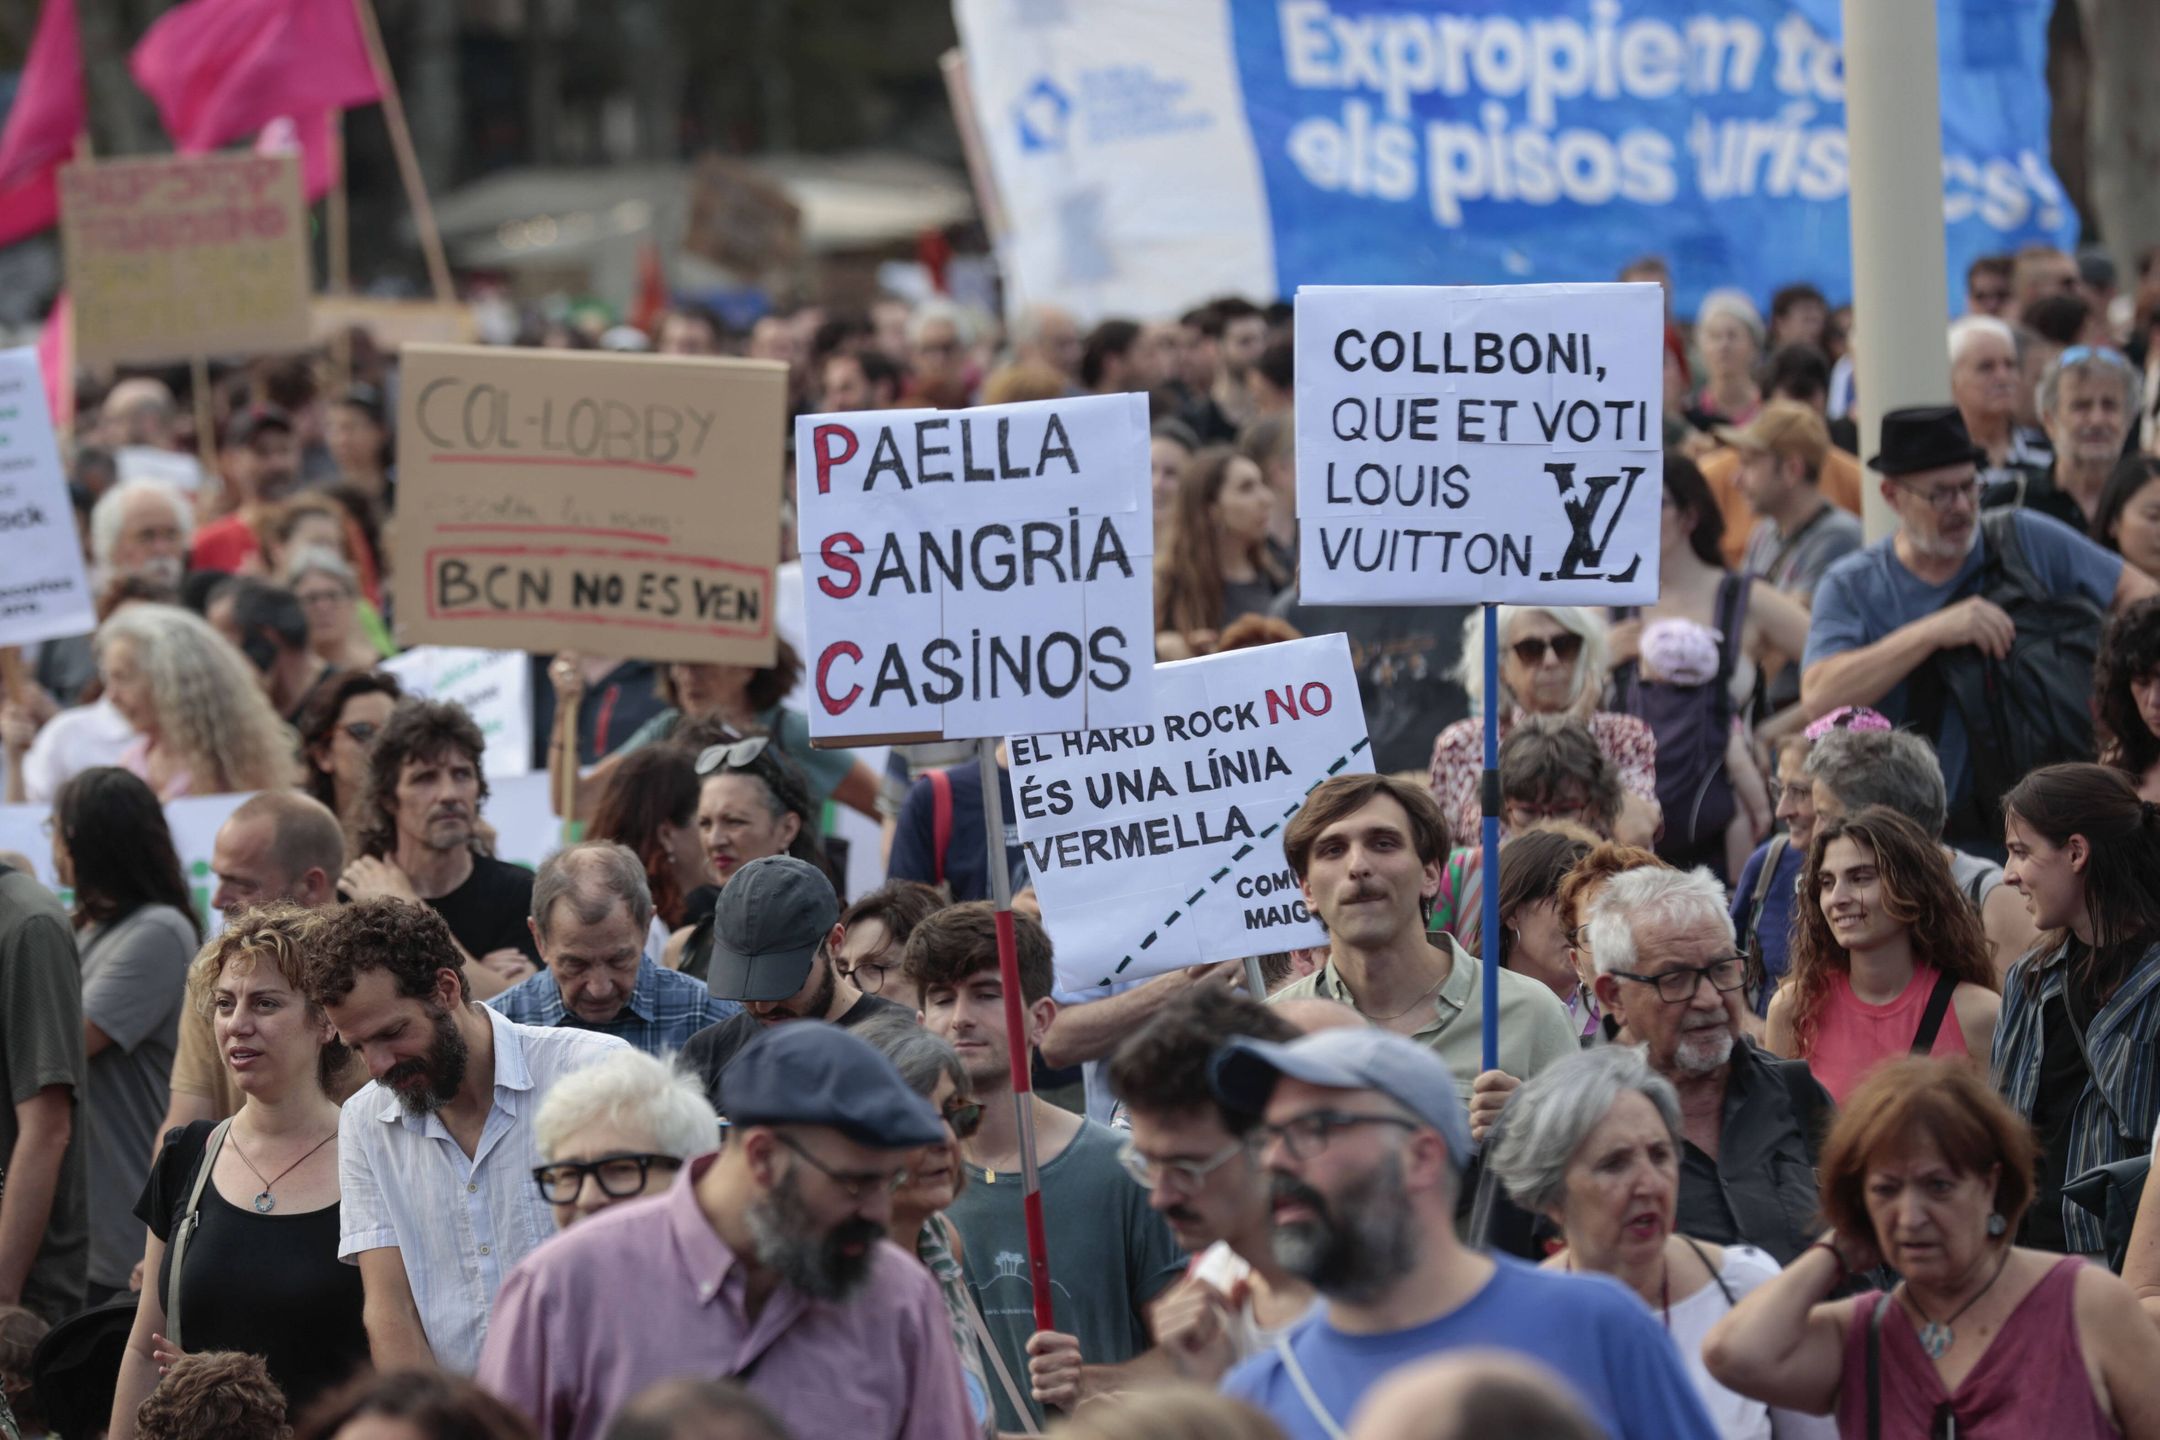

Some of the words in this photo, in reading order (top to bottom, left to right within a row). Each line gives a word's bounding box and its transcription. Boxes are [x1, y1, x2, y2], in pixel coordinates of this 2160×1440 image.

[1288, 98, 1419, 200] els
[1426, 100, 1679, 228] pisos
[1334, 328, 1607, 382] COLLBONI,
[1332, 397, 1440, 442] QUE
[1457, 399, 1519, 442] ET
[1533, 399, 1647, 442] VOTI
[812, 413, 1081, 495] PAELLA
[1326, 462, 1471, 509] LOUIS
[1319, 527, 1533, 577] VUITTON
[437, 559, 552, 612] BCN
[572, 570, 625, 611] NO
[636, 573, 682, 616] ES
[692, 580, 761, 623] VEN
[1011, 735, 1053, 766] EL
[1062, 725, 1155, 757] HARD
[1163, 701, 1259, 742] ROCK
[1264, 682, 1333, 725] NO
[1019, 776, 1074, 819] ÉS
[1085, 766, 1178, 809] UNA
[1184, 746, 1292, 793] LÍNIA
[1023, 805, 1255, 873] VERMELLA
[1244, 900, 1311, 929] MAIG
